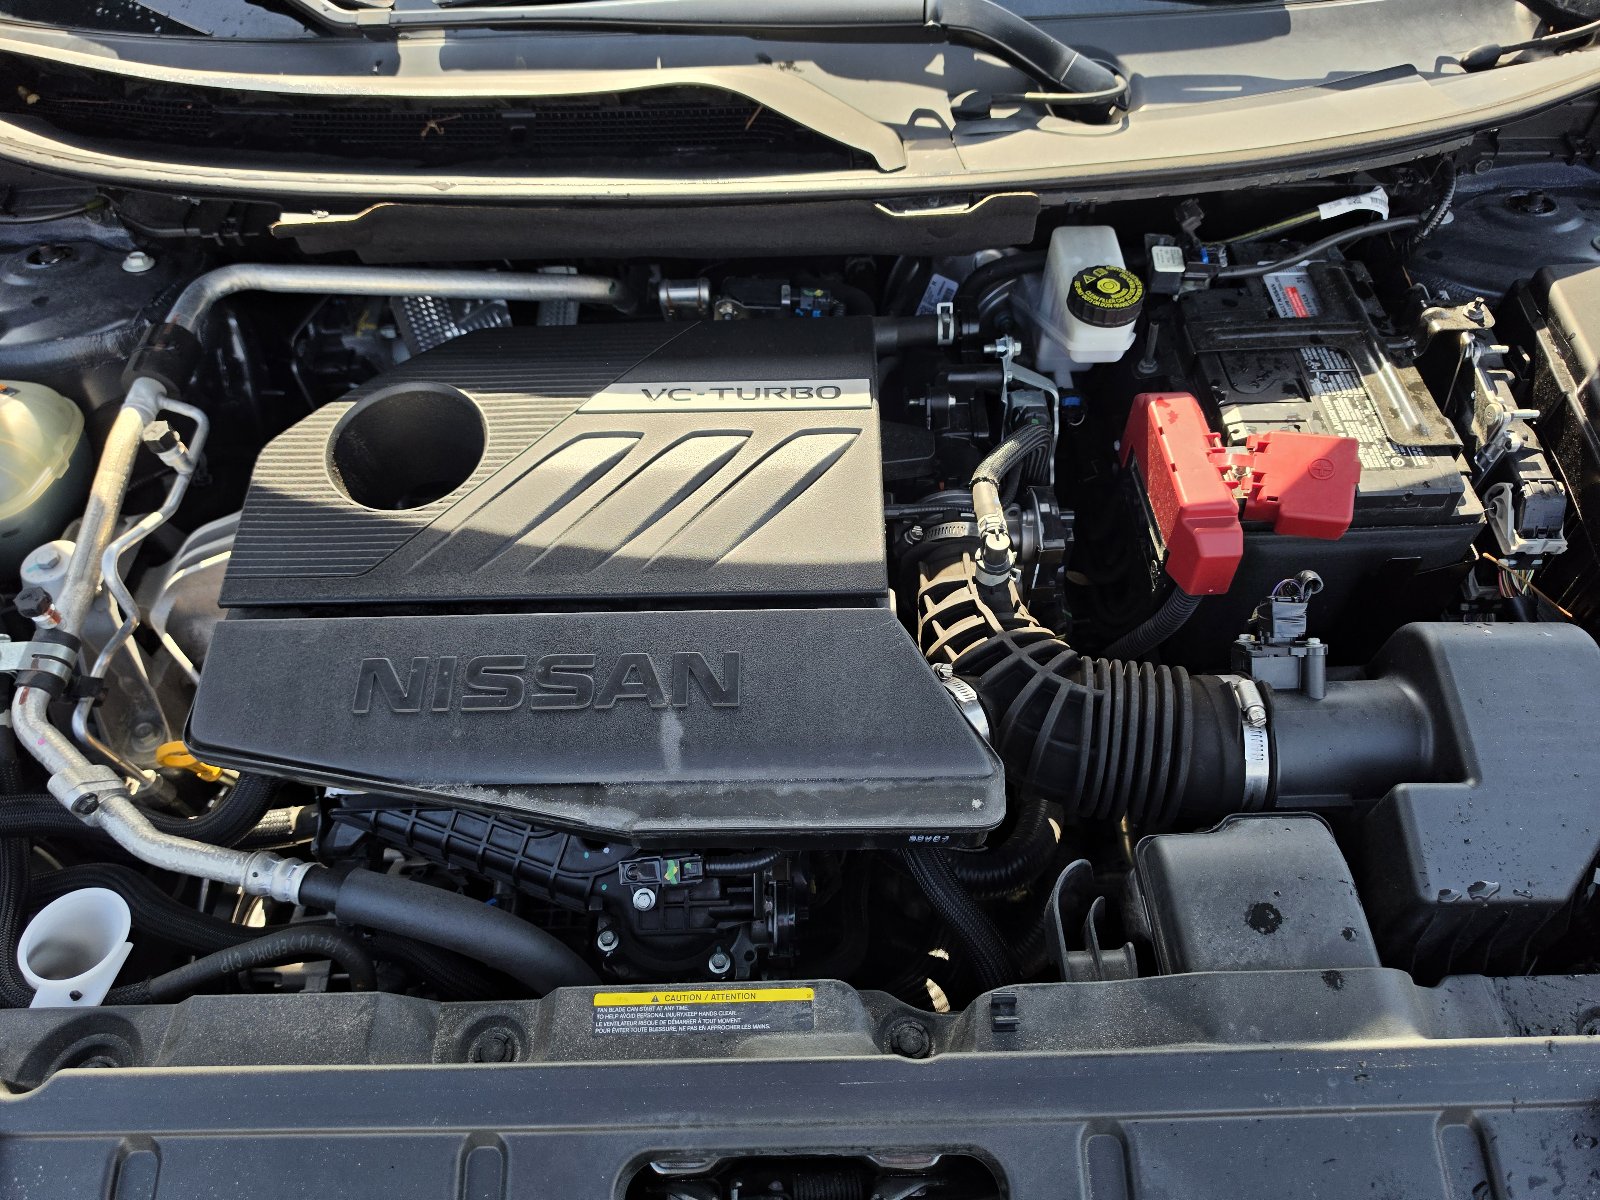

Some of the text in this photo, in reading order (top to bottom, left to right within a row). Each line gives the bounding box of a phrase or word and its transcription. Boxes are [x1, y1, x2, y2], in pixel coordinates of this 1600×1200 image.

[641, 385, 842, 402] VC-TURBO
[352, 650, 741, 713] NISSAN
[664, 993, 702, 1002] CAUTION
[710, 992, 756, 1001] ATTENTION
[636, 1011, 665, 1019] PERSONAL
[603, 1019, 638, 1027] VENTILATEUR
[686, 1024, 698, 1032] PAS
[707, 1023, 741, 1031] APPROCHER
